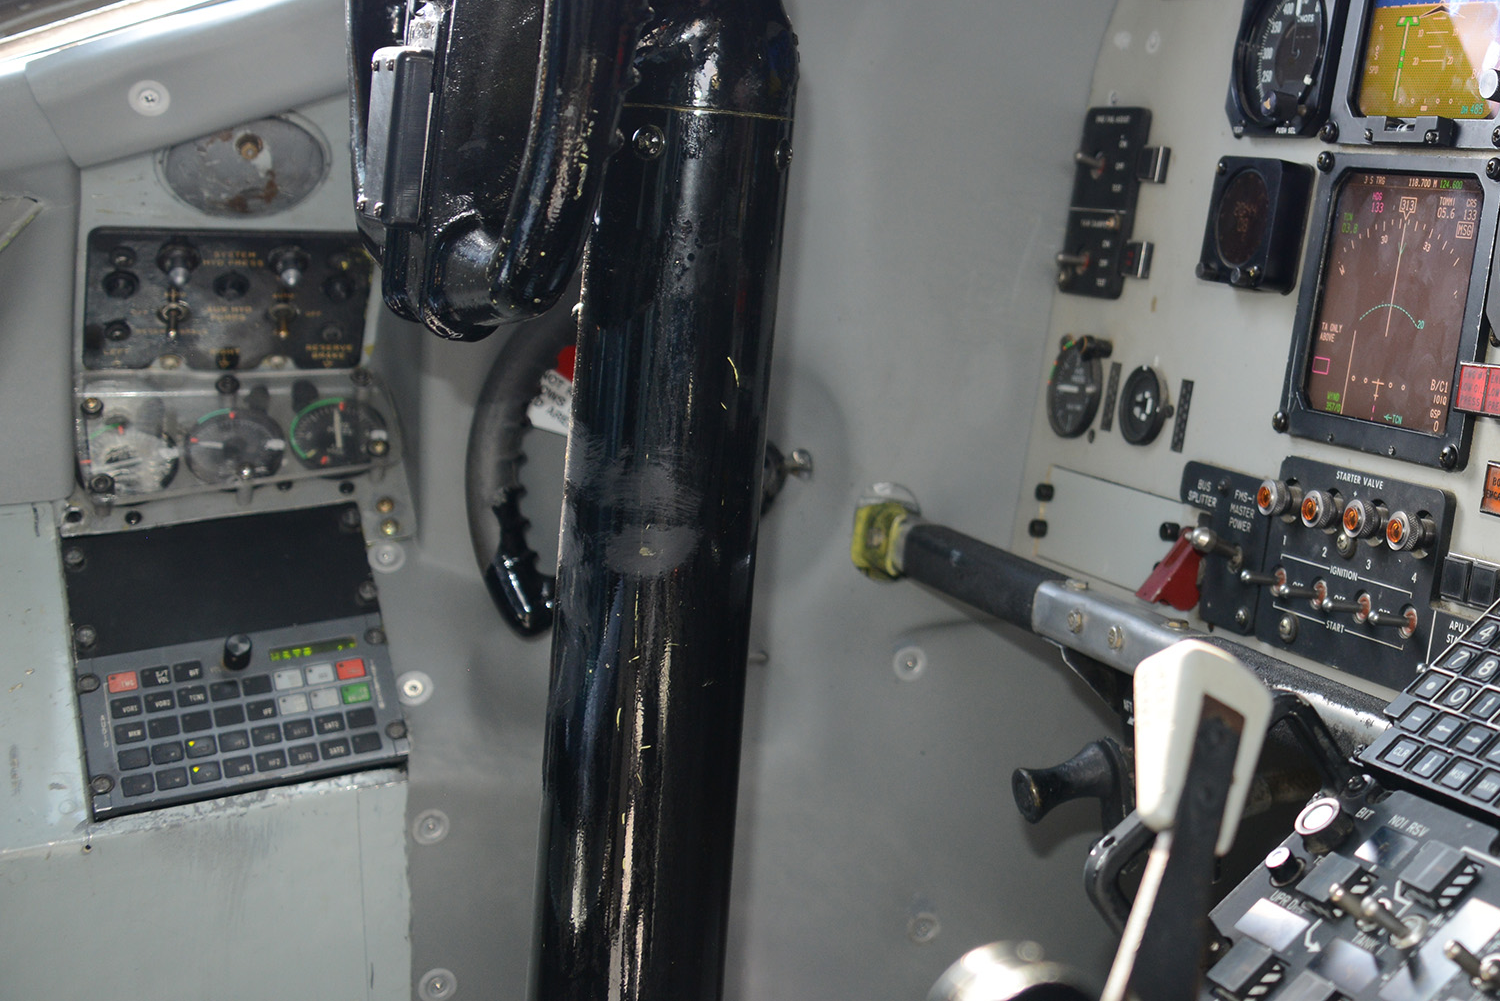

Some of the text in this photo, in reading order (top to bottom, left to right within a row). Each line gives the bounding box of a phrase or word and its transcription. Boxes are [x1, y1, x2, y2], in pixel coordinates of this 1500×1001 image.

[1298, 14, 1314, 23] NOTS
[1470, 104, 1484, 115] 485
[1409, 178, 1431, 187] 118.700
[1440, 179, 1462, 189] 124.600
[1371, 203, 1384, 213] 133
[1401, 200, 1414, 211] 313
[1466, 199, 1477, 207] CRS
[1438, 207, 1455, 219] 05.6
[1464, 210, 1477, 220] 133
[1458, 224, 1472, 236] MSG
[1381, 235, 1388, 244] 30
[1423, 241, 1431, 253] 33
[1322, 322, 1343, 333] TA ONLY
[1320, 333, 1335, 342] ABOVE
[1197, 479, 1211, 492] BUS
[1336, 470, 1384, 490] STARTER VALVE
[1187, 492, 1217, 508] SPLITTER
[1229, 503, 1255, 519] MASTER
[1228, 517, 1251, 533] POWER
[1329, 565, 1358, 582] IGNITION
[1326, 620, 1344, 634] START
[1449, 621, 1464, 632] APU
[1478, 623, 1494, 640] 4
[1455, 652, 1470, 666] 7
[1479, 660, 1494, 677] 8
[1392, 746, 1498, 794] CLR MSN DATA
[1353, 807, 1376, 823] BIT
[1406, 821, 1430, 837] RSV
